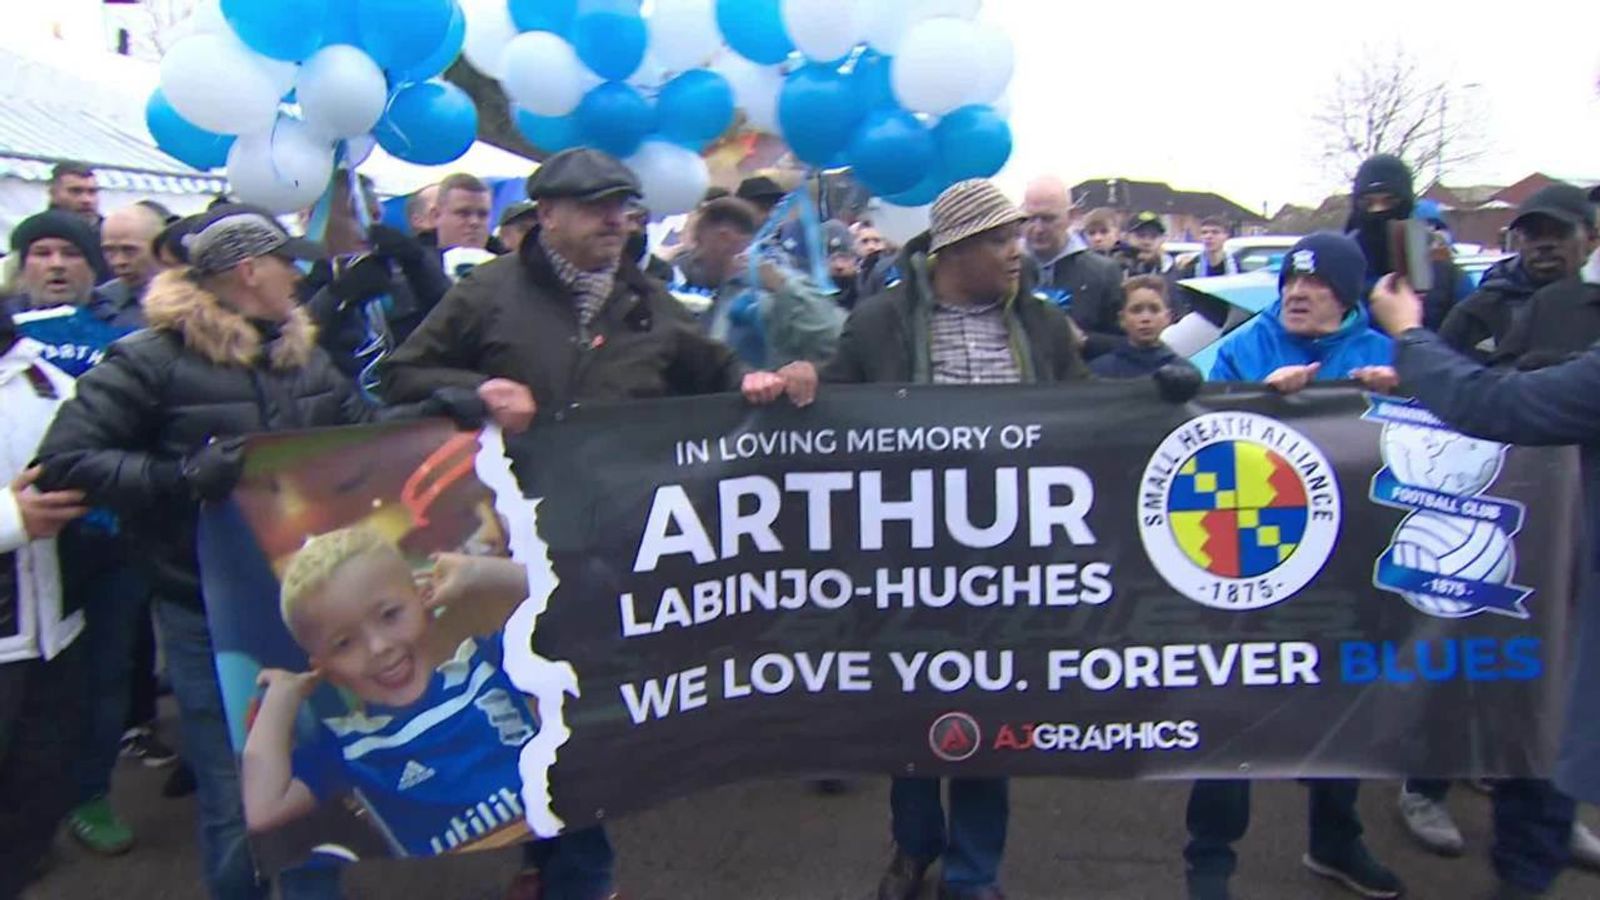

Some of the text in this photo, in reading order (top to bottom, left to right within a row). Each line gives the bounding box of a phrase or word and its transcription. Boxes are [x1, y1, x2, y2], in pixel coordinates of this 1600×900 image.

[676, 424, 1041, 465] IN LOVING MEMORY OF
[1145, 417, 1333, 527] SMALL HEATH ALLIANCE
[632, 466, 1097, 573] ARTHUR
[1391, 486, 1501, 519] FOOTBALL CLUB
[620, 563, 1113, 637] LABINJO-HUGHES
[620, 637, 1542, 725] WE LOVE YOU. FOREVER BLUES
[994, 721, 1199, 751] AJGRAPHICS
